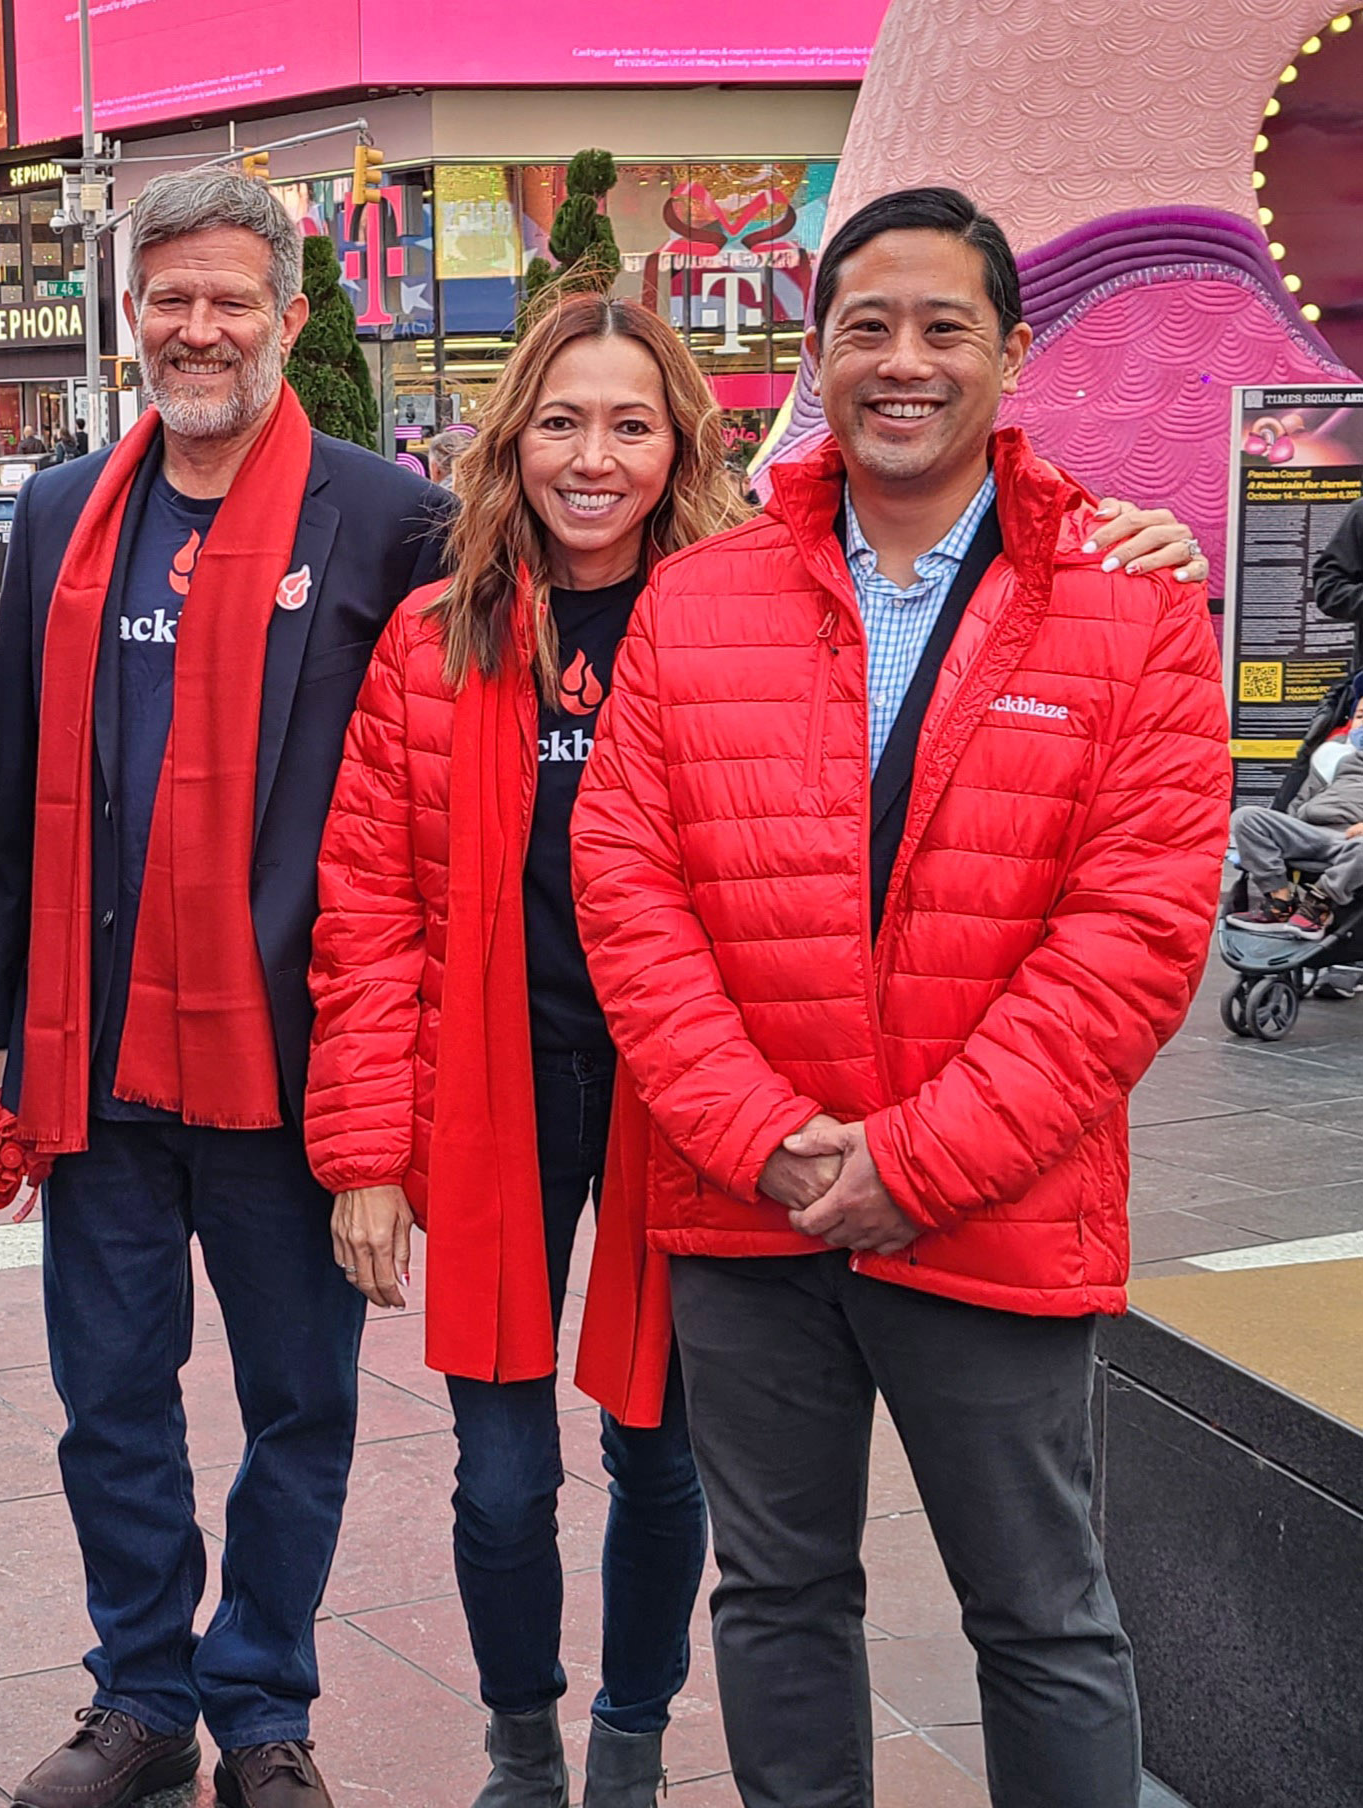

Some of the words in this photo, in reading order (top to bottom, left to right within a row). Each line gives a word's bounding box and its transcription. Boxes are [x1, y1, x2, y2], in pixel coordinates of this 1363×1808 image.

[9, 163, 64, 187] SEPHORA
[48, 283, 58, 295] W
[61, 283, 74, 295] 46
[702, 272, 762, 355] T
[1265, 394, 1302, 404] TIMES
[1304, 393, 1344, 405] SQUARE
[1280, 469, 1312, 479] Council
[1246, 491, 1282, 500] October
